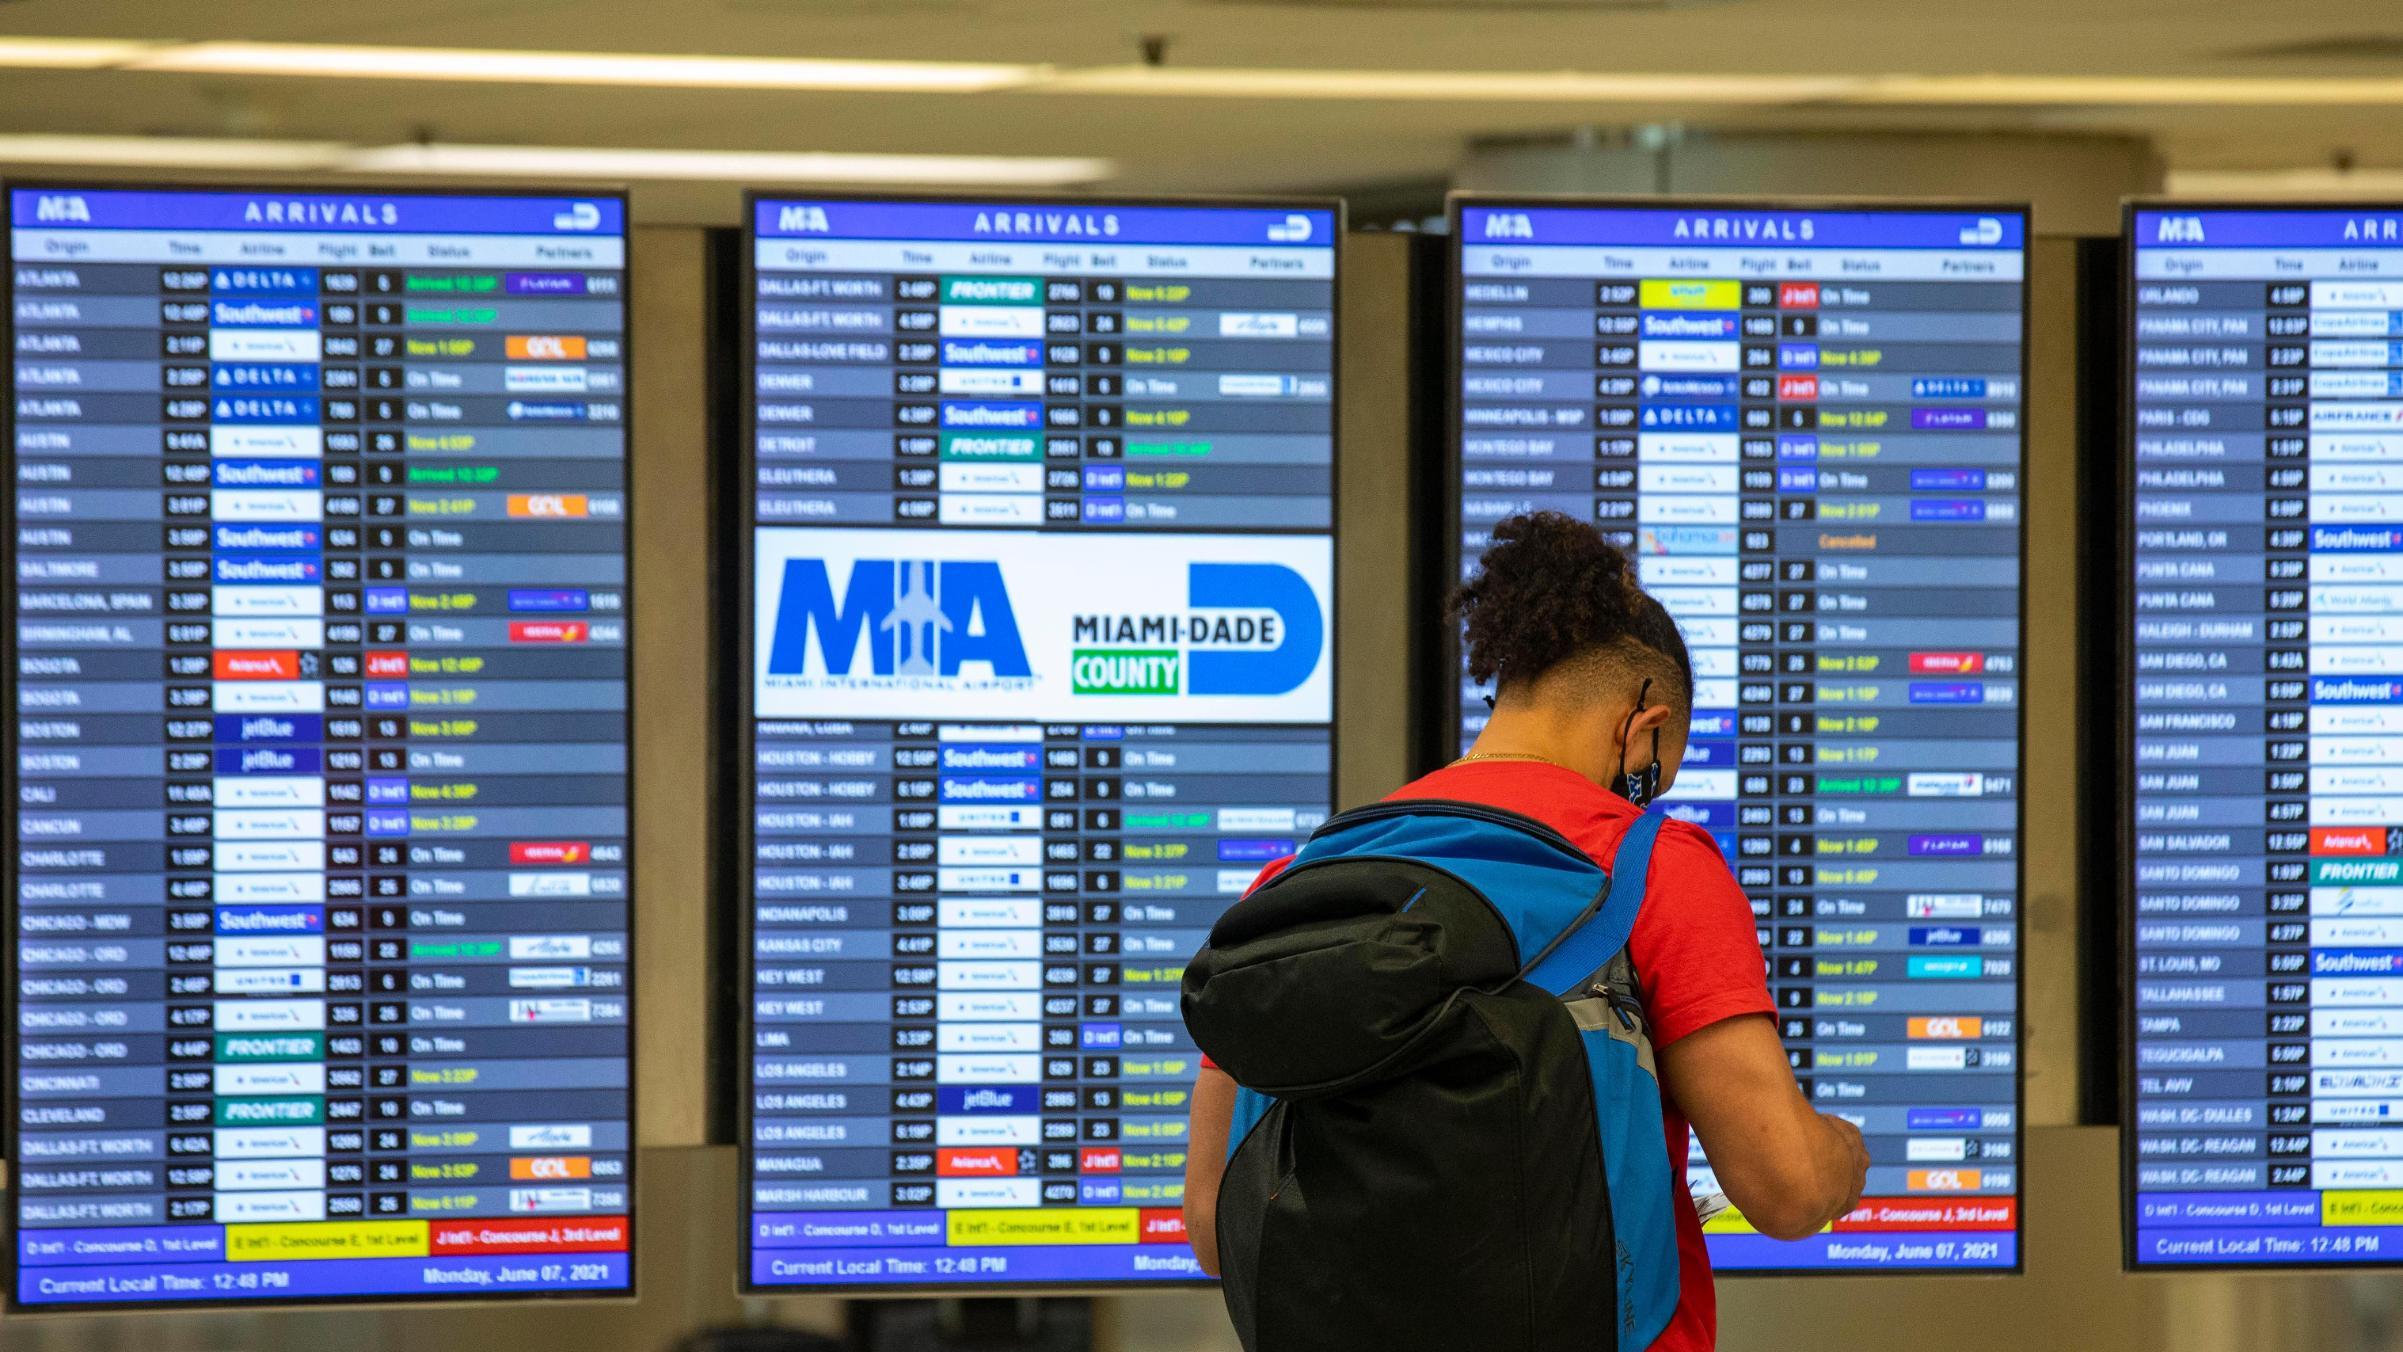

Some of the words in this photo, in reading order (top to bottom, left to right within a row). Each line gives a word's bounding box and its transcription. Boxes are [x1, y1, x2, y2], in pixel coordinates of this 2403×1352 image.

[245, 201, 398, 225] ARRIVALS
[974, 212, 1120, 236] ARRIVALS
[1674, 218, 1815, 240] ARRIVALS
[45, 238, 89, 257] Origin
[170, 241, 200, 253] Time
[240, 243, 284, 255] Airline
[319, 243, 357, 258] Flight
[369, 244, 395, 257] Belt
[428, 245, 470, 258] Status
[536, 245, 592, 260] Partners
[786, 248, 827, 265] Origin
[903, 250, 932, 263] Time
[970, 252, 1011, 265] Airline
[1044, 254, 1080, 269] Flight
[1091, 255, 1116, 267] Belt
[1147, 255, 1188, 267] Status
[1251, 257, 1303, 270] Partners
[1492, 255, 1531, 271] Origin
[1605, 256, 1633, 268] Time
[1669, 257, 1709, 269] Airline
[1788, 259, 1811, 271] Belt
[1842, 259, 1880, 271] Status
[2276, 259, 2303, 271] Time
[2340, 259, 2379, 271] Airline
[1742, 259, 1776, 273] Flight
[1943, 259, 1994, 273] Partners
[2165, 258, 2203, 273] Origin
[233, 272, 296, 288] DELTA
[950, 281, 1035, 299] FRONTIER
[1841, 289, 1870, 304] Time
[215, 303, 302, 324] Southwest
[1644, 315, 1722, 336] Southwest
[945, 344, 1027, 364] Southwest
[234, 368, 296, 386] DELTA
[431, 373, 460, 388] Time
[234, 401, 297, 418] DELTA
[1667, 408, 1717, 424] DELTA
[950, 440, 1033, 457] FRONTIER
[216, 463, 302, 486] Southwest
[2314, 529, 2391, 549] Southwest
[218, 559, 303, 580] Southwest
[768, 558, 1032, 677] MIA
[1073, 614, 1276, 643] MIAMI-DADE
[1073, 656, 1178, 688] COUNTY
[765, 679, 813, 688] MIAMI
[821, 679, 956, 690] INTERNATIONAL
[963, 679, 1034, 690] AIRPORT
[2314, 681, 2391, 700] Southwest
[242, 718, 293, 739] jetBlue
[242, 750, 293, 771] jetBlue
[945, 749, 1026, 769] Southwest
[945, 780, 1026, 800] Southwest
[2319, 862, 2399, 880] FRONTIER
[2316, 953, 2392, 973] Southwest
[1926, 1019, 1962, 1038] GOL
[226, 1038, 315, 1057] FRONTIER
[964, 1090, 1012, 1110] jetBlue
[226, 1101, 315, 1121] FRONTIER
[1926, 1172, 1962, 1190] GOL
[1880, 1207, 1941, 1222] Concourse
[1977, 1207, 2008, 1221] Level
[2186, 1203, 2247, 1217] Concourse
[2284, 1202, 2314, 1215] Level
[480, 1229, 547, 1244] Concourse
[585, 1228, 620, 1241] Level
[804, 1224, 868, 1237] Concourse
[907, 1223, 939, 1235] Level
[74, 1240, 141, 1255] Concourse
[184, 1238, 218, 1251] Level
[1828, 1243, 1891, 1262] Monday,
[1895, 1243, 1932, 1260] June
[1963, 1242, 1997, 1259] 2021
[2156, 1238, 2214, 1255] Current
[2218, 1237, 2260, 1254] Local
[2265, 1236, 2305, 1253] Time:
[2311, 1236, 2350, 1252] 12:48
[2354, 1236, 2379, 1251] PM
[772, 1259, 833, 1275] Current
[837, 1259, 880, 1275] Local
[886, 1258, 927, 1274] Time:
[935, 1257, 977, 1273] 12:48
[981, 1257, 1006, 1272] PM
[39, 1277, 105, 1294] Current
[110, 1275, 156, 1293] Local
[161, 1275, 204, 1290] Time:
[214, 1273, 258, 1289] 12:48
[262, 1272, 289, 1288] PM
[424, 1267, 493, 1286] Monday,
[497, 1266, 538, 1283] June
[541, 1265, 567, 1283] 07,
[570, 1264, 608, 1281] 2021
